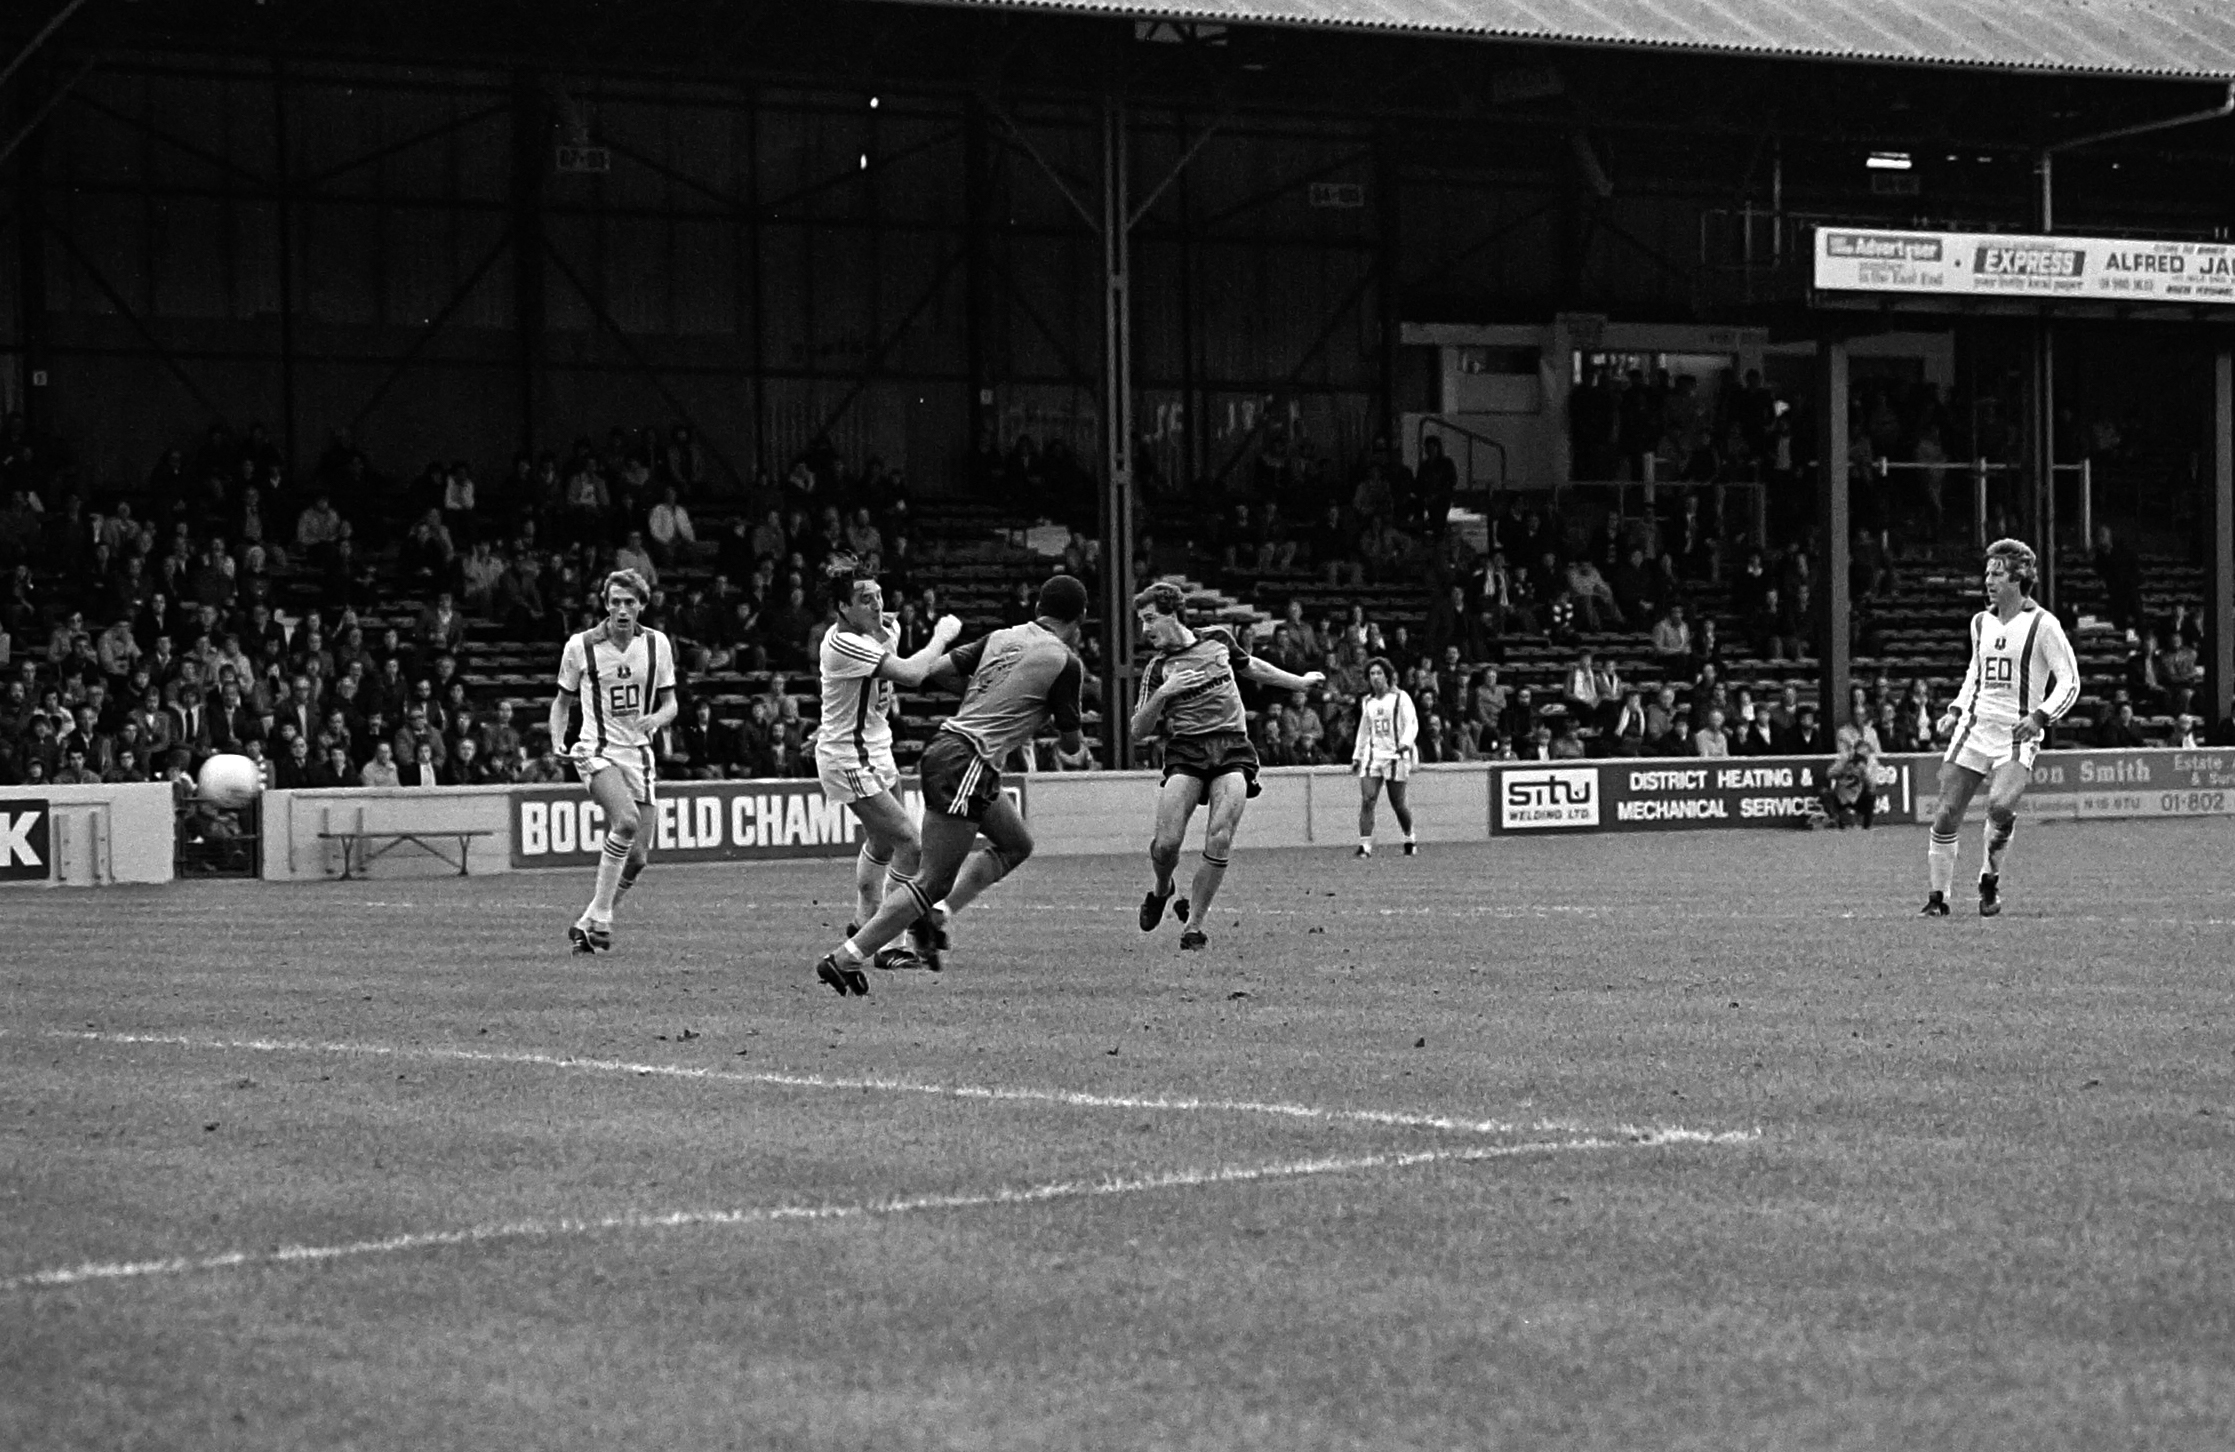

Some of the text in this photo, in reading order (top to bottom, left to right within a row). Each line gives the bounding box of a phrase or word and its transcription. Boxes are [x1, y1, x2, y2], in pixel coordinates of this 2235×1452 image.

[1985, 249, 2076, 276] EXPRESS
[2106, 252, 2184, 273] ALFRED
[1985, 656, 2012, 681] ED
[610, 684, 640, 710] ED
[2080, 757, 2150, 784] Smith
[2174, 753, 2222, 770] Estate
[1630, 770, 1707, 790] DISTRICT
[1717, 767, 1793, 789] HEATING
[1800, 767, 1813, 787] &
[1509, 808, 1590, 821] WELDING LTD
[1617, 798, 1729, 820] MECHANICAL
[0, 811, 43, 867] K
